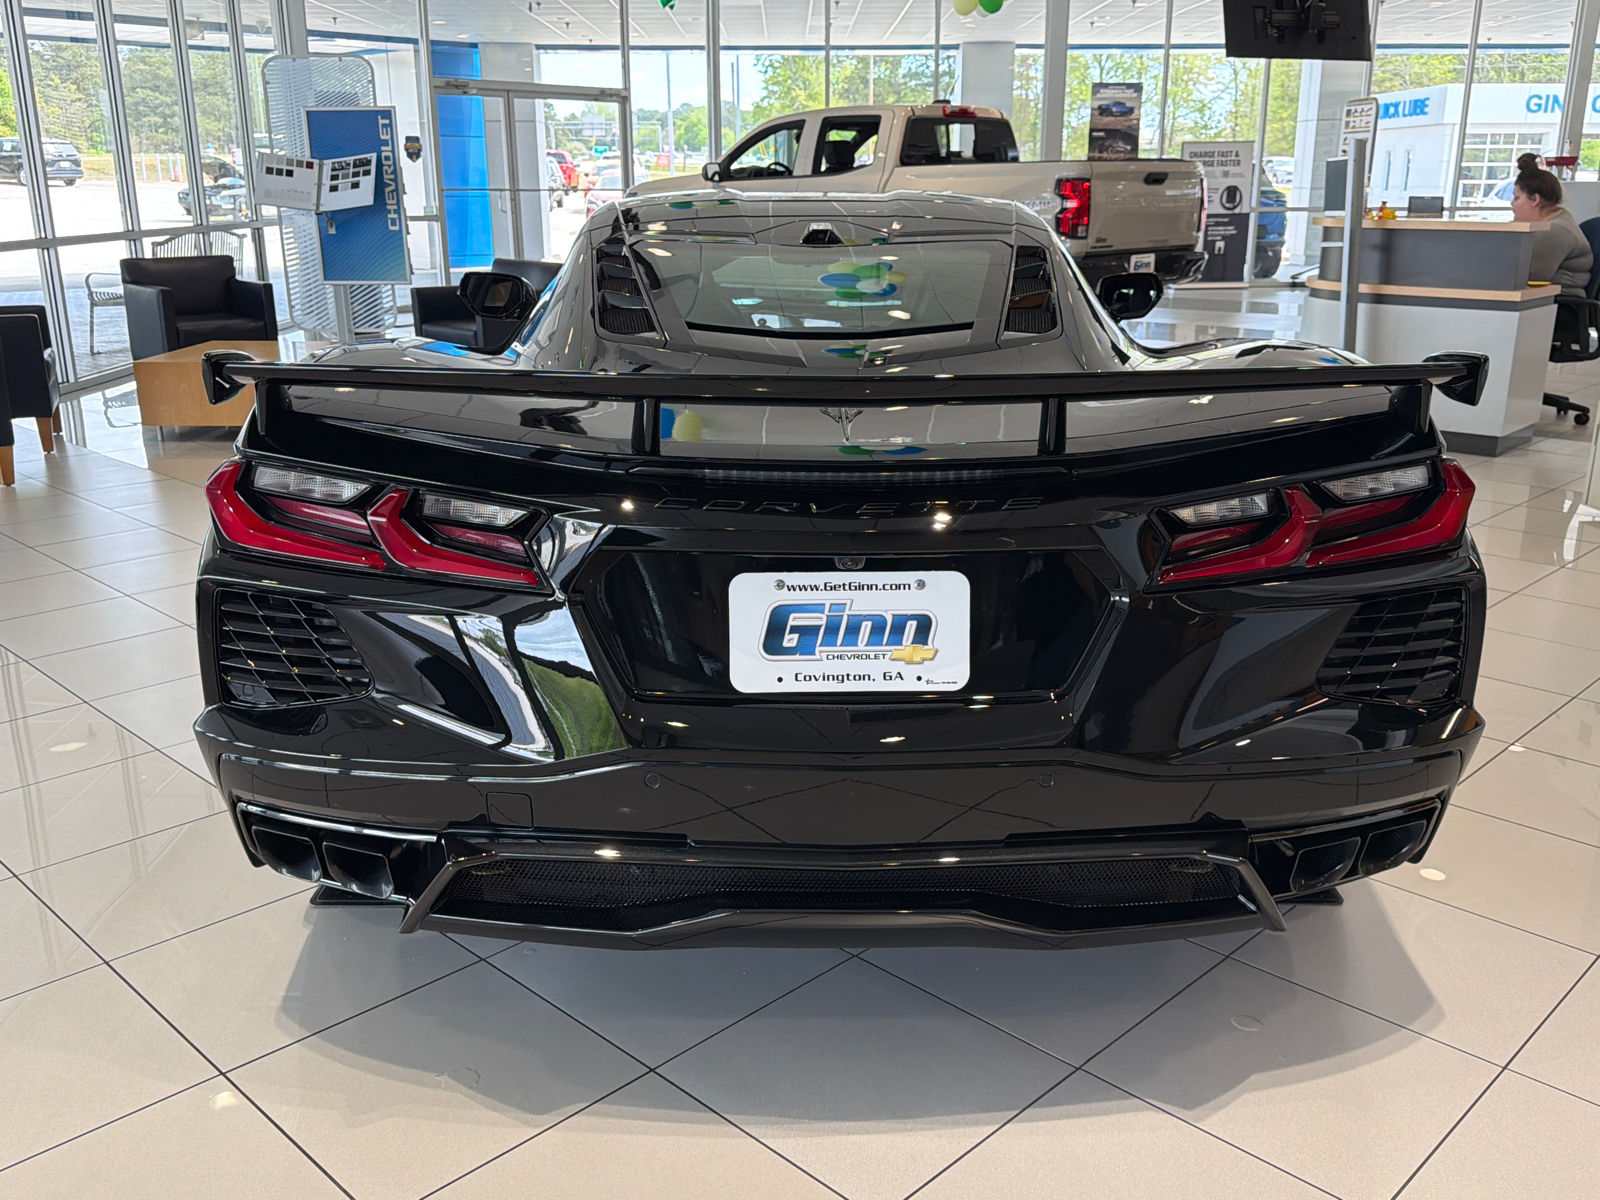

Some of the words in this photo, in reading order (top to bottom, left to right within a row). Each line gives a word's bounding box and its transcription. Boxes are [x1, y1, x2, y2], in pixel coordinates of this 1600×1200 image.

[1378, 101, 1402, 119] UICK
[1402, 97, 1430, 117] LUBE
[1525, 94, 1563, 113] GIN
[1188, 150, 1216, 159] CHARGE
[1216, 150, 1234, 158] FAST
[1216, 159, 1241, 167] FASTER
[378, 115, 400, 231] CHEVROLET
[653, 496, 1045, 515] CORVETTE
[786, 581, 911, 592] www.GetGinn.com
[760, 600, 936, 658] Ginn
[825, 652, 888, 661] CHEVROLET
[794, 671, 876, 684] Covington,
[882, 670, 905, 682] GA
